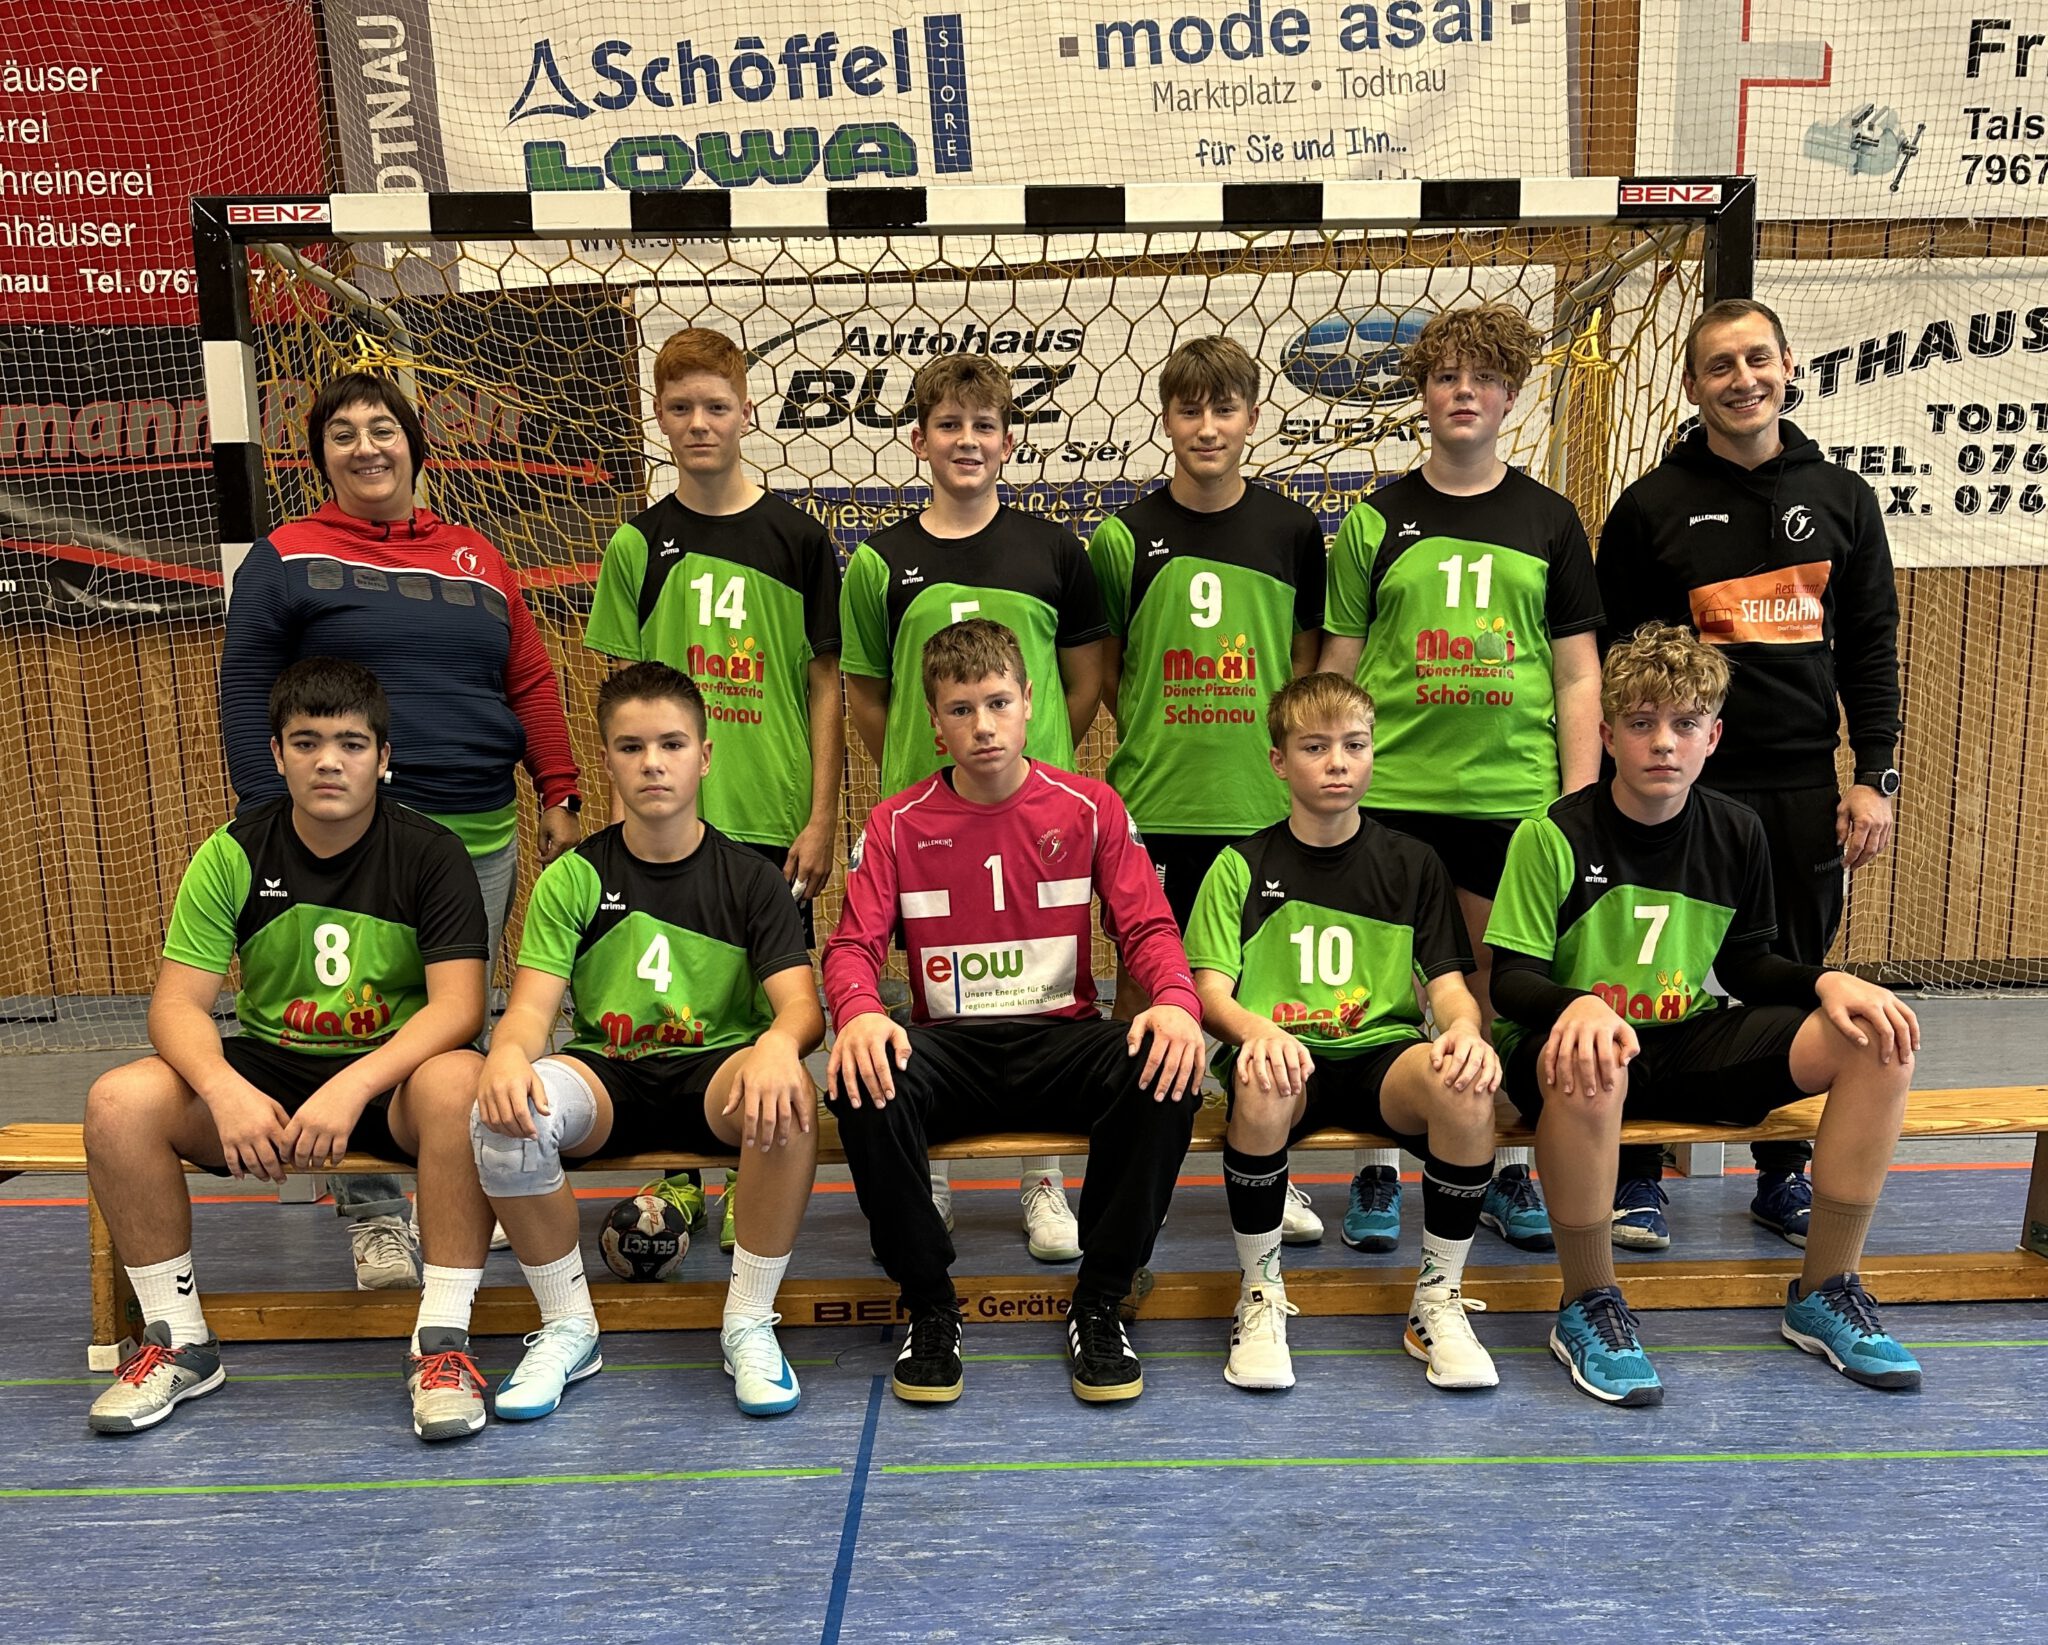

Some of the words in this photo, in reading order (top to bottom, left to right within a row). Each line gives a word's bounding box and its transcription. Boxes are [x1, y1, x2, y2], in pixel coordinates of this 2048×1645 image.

[1095, 0, 1311, 70] mode
[1966, 19, 2046, 78] Fr
[938, 30, 958, 157] STORE
[1153, 73, 1298, 115] Marktplatz
[1336, 65, 1447, 101] Todtnau
[356, 15, 433, 264] TDTNAU
[1963, 107, 2046, 142] Tals
[523, 122, 918, 192] LOWA
[1195, 139, 1236, 168] für
[1247, 135, 1285, 164] Sie
[1293, 130, 1335, 161] und
[1621, 184, 1715, 203] BENZ
[229, 205, 322, 223] BENZ
[80, 268, 131, 294] Tel.
[833, 324, 1083, 357] Autohaus
[776, 364, 1076, 429] BUZ
[1827, 445, 1932, 476] TEL.
[1399, 529, 1421, 538] erima
[660, 547, 680, 557] erima
[1148, 547, 1170, 557] erima
[902, 576, 924, 585] erima
[1438, 554, 1494, 609] 11
[690, 573, 747, 630] 14
[1189, 571, 1222, 628] 9
[1741, 597, 1820, 623] SEILBAHN
[1164, 647, 1256, 682] Maxi
[1164, 683, 1257, 698] Döner-Pizzeria
[1415, 684, 1514, 706] Schönau
[1164, 703, 1256, 725] Schönau
[917, 838, 953, 850] HALLENKIND
[260, 889, 288, 898] erima
[983, 854, 1006, 911] 1
[1261, 890, 1285, 898] erima
[1585, 875, 1608, 884] erima
[600, 901, 626, 911] erima
[1634, 905, 1670, 965] 7
[313, 923, 351, 986] 8
[636, 933, 673, 993] 4
[1290, 925, 1354, 986] 10
[283, 993, 391, 1037] Maxi
[622, 1234, 676, 1255] SELECT
